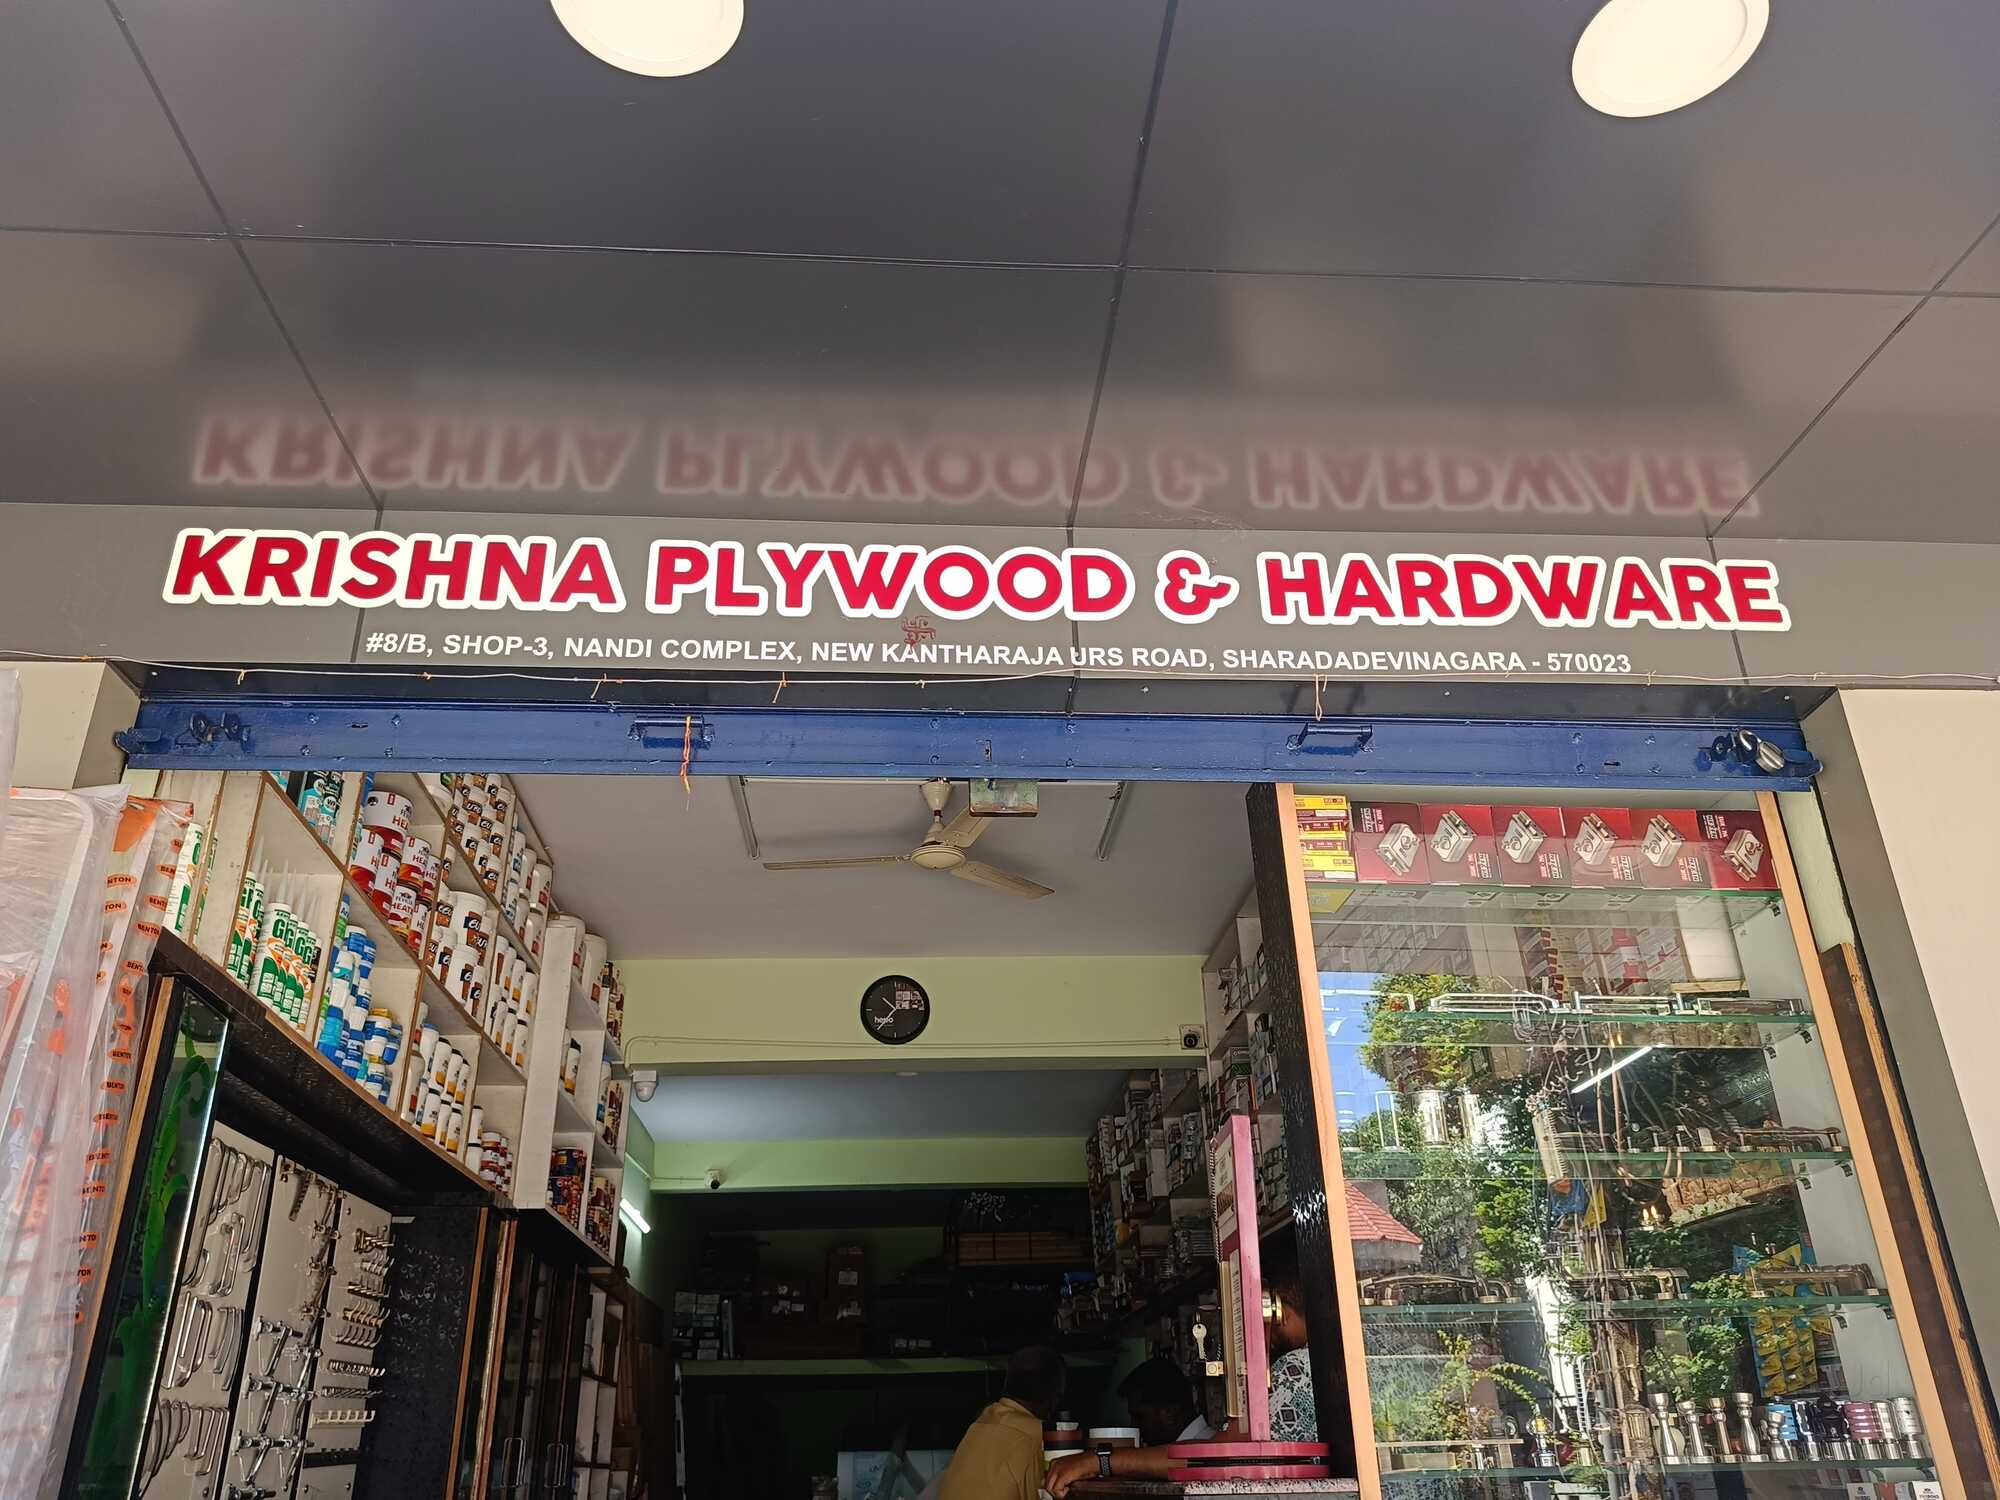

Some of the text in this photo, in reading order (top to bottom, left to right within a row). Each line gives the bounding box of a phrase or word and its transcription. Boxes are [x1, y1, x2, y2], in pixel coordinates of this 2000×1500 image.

[163, 529, 1789, 631] KRISHNA PLYWOOD & HARDWARE
[366, 633, 433, 657] #8/B,
[443, 635, 554, 659] SHOP-3,
[565, 638, 653, 658] NANDI
[661, 640, 802, 664] COMPLEX,
[812, 642, 874, 662] NEW
[883, 644, 1064, 666] KANTHARAJA
[1071, 646, 1123, 667] URS
[1132, 648, 1215, 671] ROAD,
[1223, 650, 1524, 672] SHARADADEVINAGARA
[1547, 653, 1632, 673] 570023
